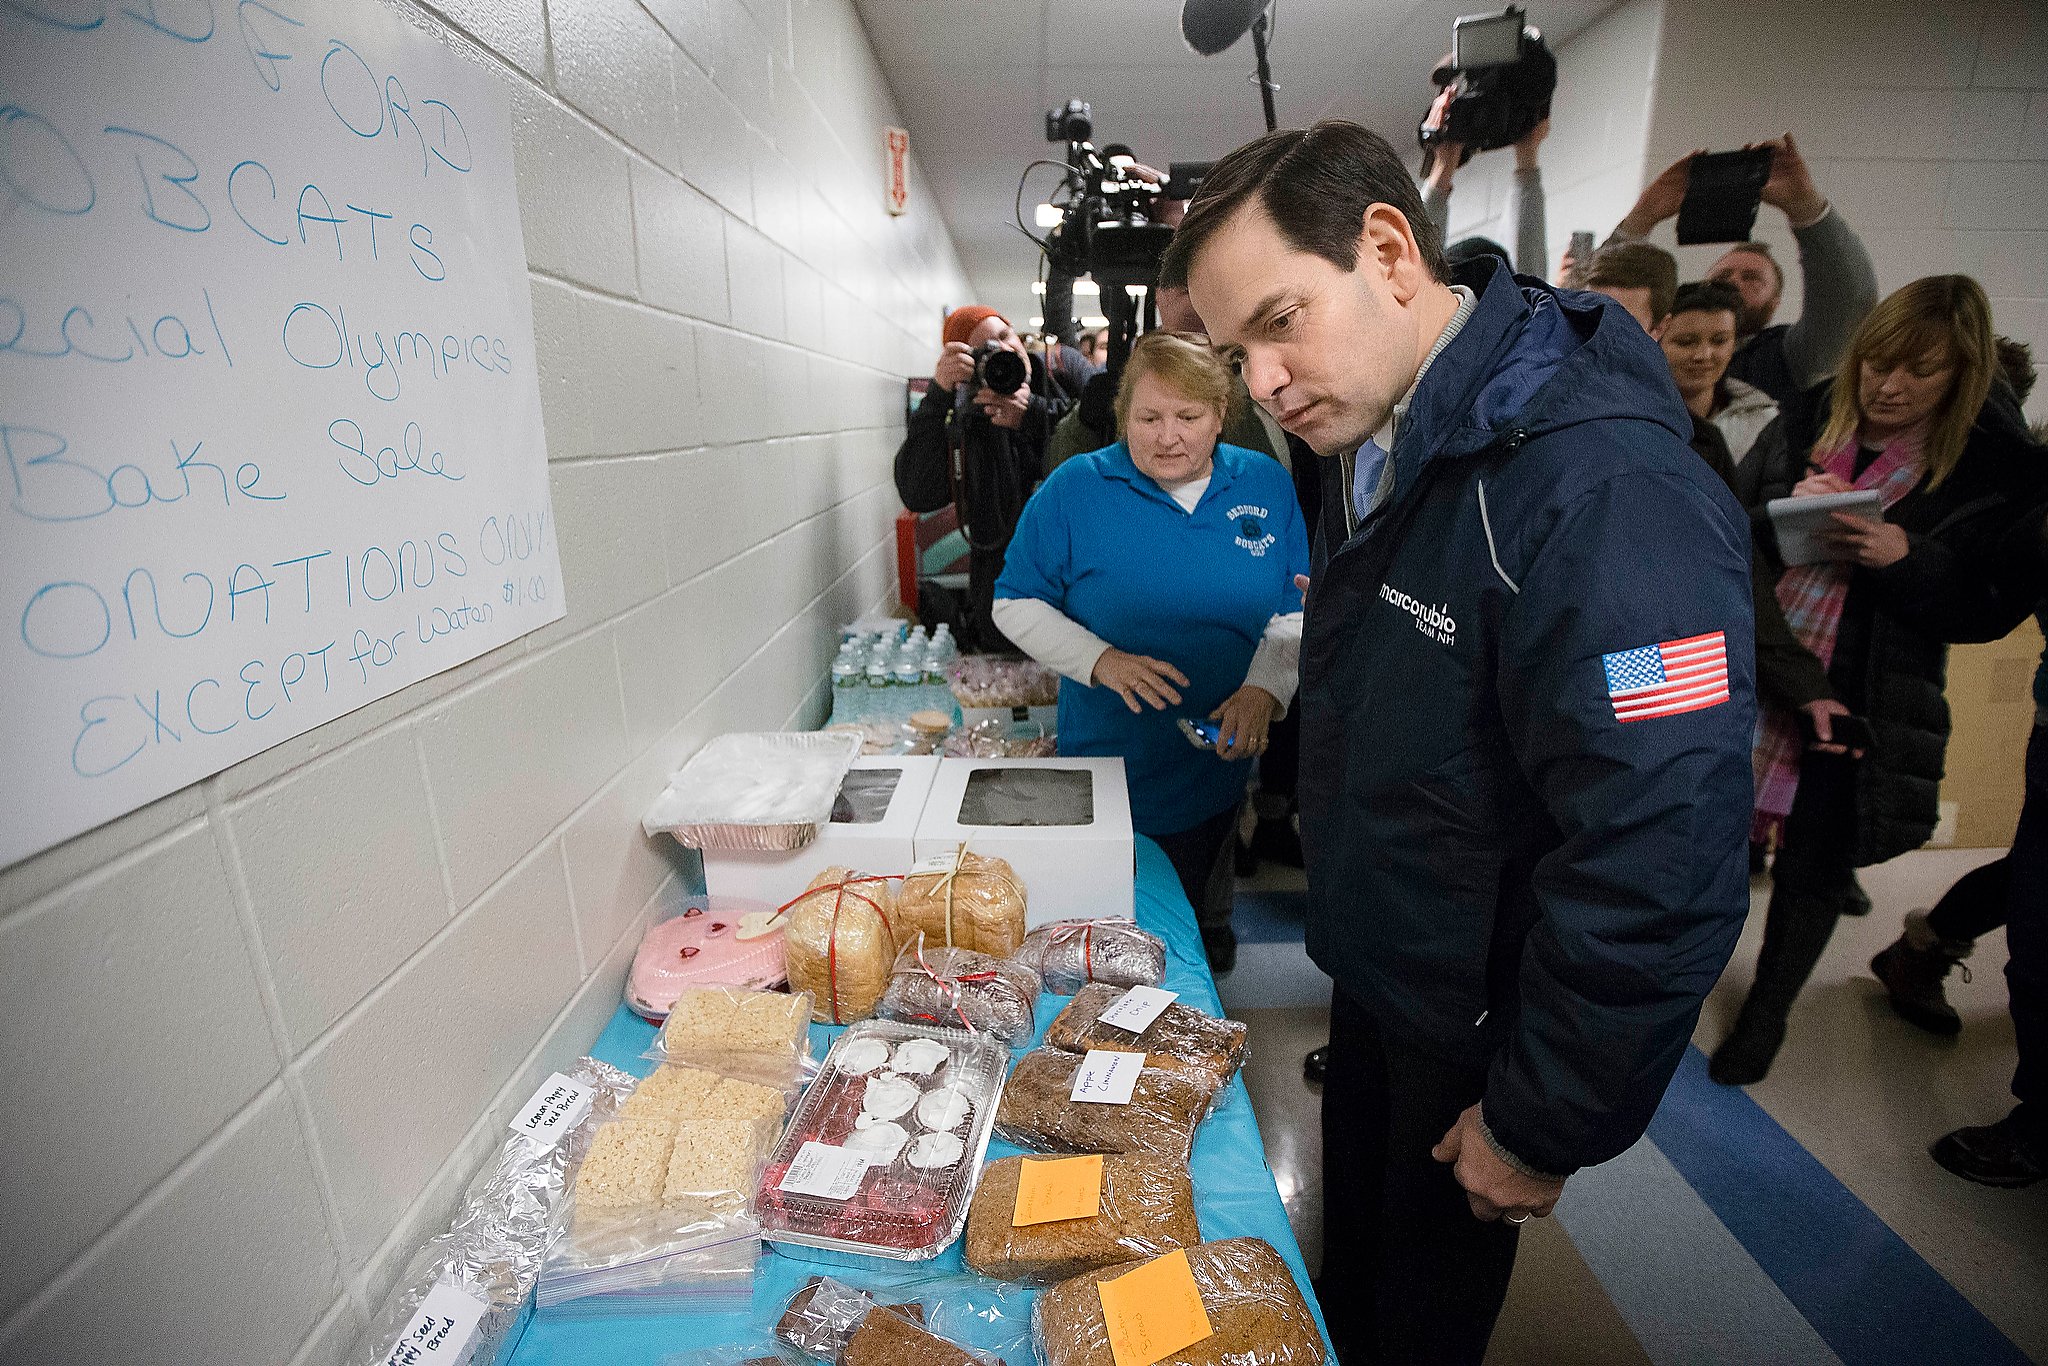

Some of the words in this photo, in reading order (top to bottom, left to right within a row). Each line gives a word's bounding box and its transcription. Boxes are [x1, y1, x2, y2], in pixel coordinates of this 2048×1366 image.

[283, 302, 511, 401] Olympics
[0, 423, 287, 522] Bake
[328, 419, 466, 485] Sale
[1379, 583, 1456, 633] marcorubio
[1415, 617, 1435, 638] TEAM
[1437, 631, 1455, 646] NH
[72, 640, 336, 778] EXCEPT
[349, 628, 406, 684] for
[525, 1105, 549, 1129] Lemon
[543, 1110, 561, 1127] Seed
[556, 1089, 580, 1112] Bread
[412, 1315, 436, 1342] Seed
[427, 1316, 455, 1351] Bread
